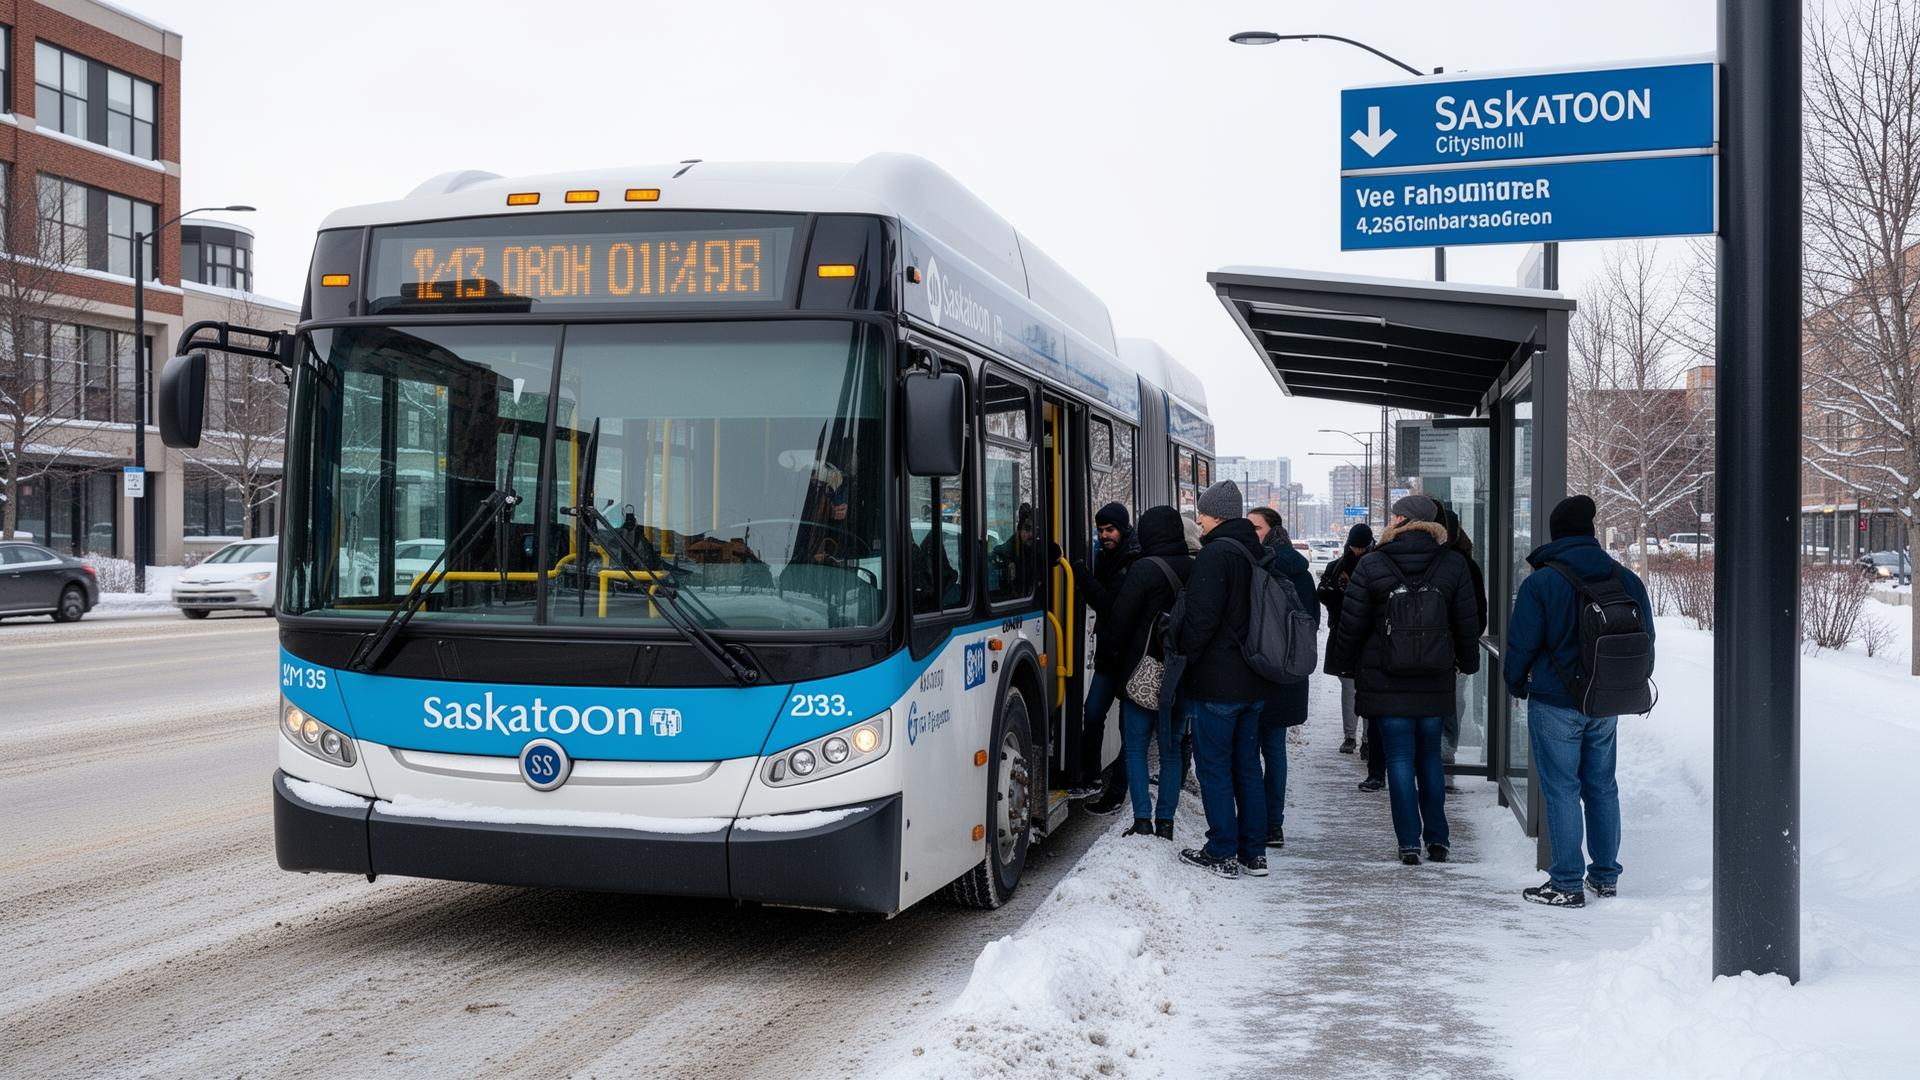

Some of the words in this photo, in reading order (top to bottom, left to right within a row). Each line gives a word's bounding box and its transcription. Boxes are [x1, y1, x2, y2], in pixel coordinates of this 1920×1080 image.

[1356, 188, 1395, 208] Vee
[942, 273, 990, 337] Saskatoon
[423, 692, 643, 736] Saskatoon
[531, 754, 553, 776] SS
